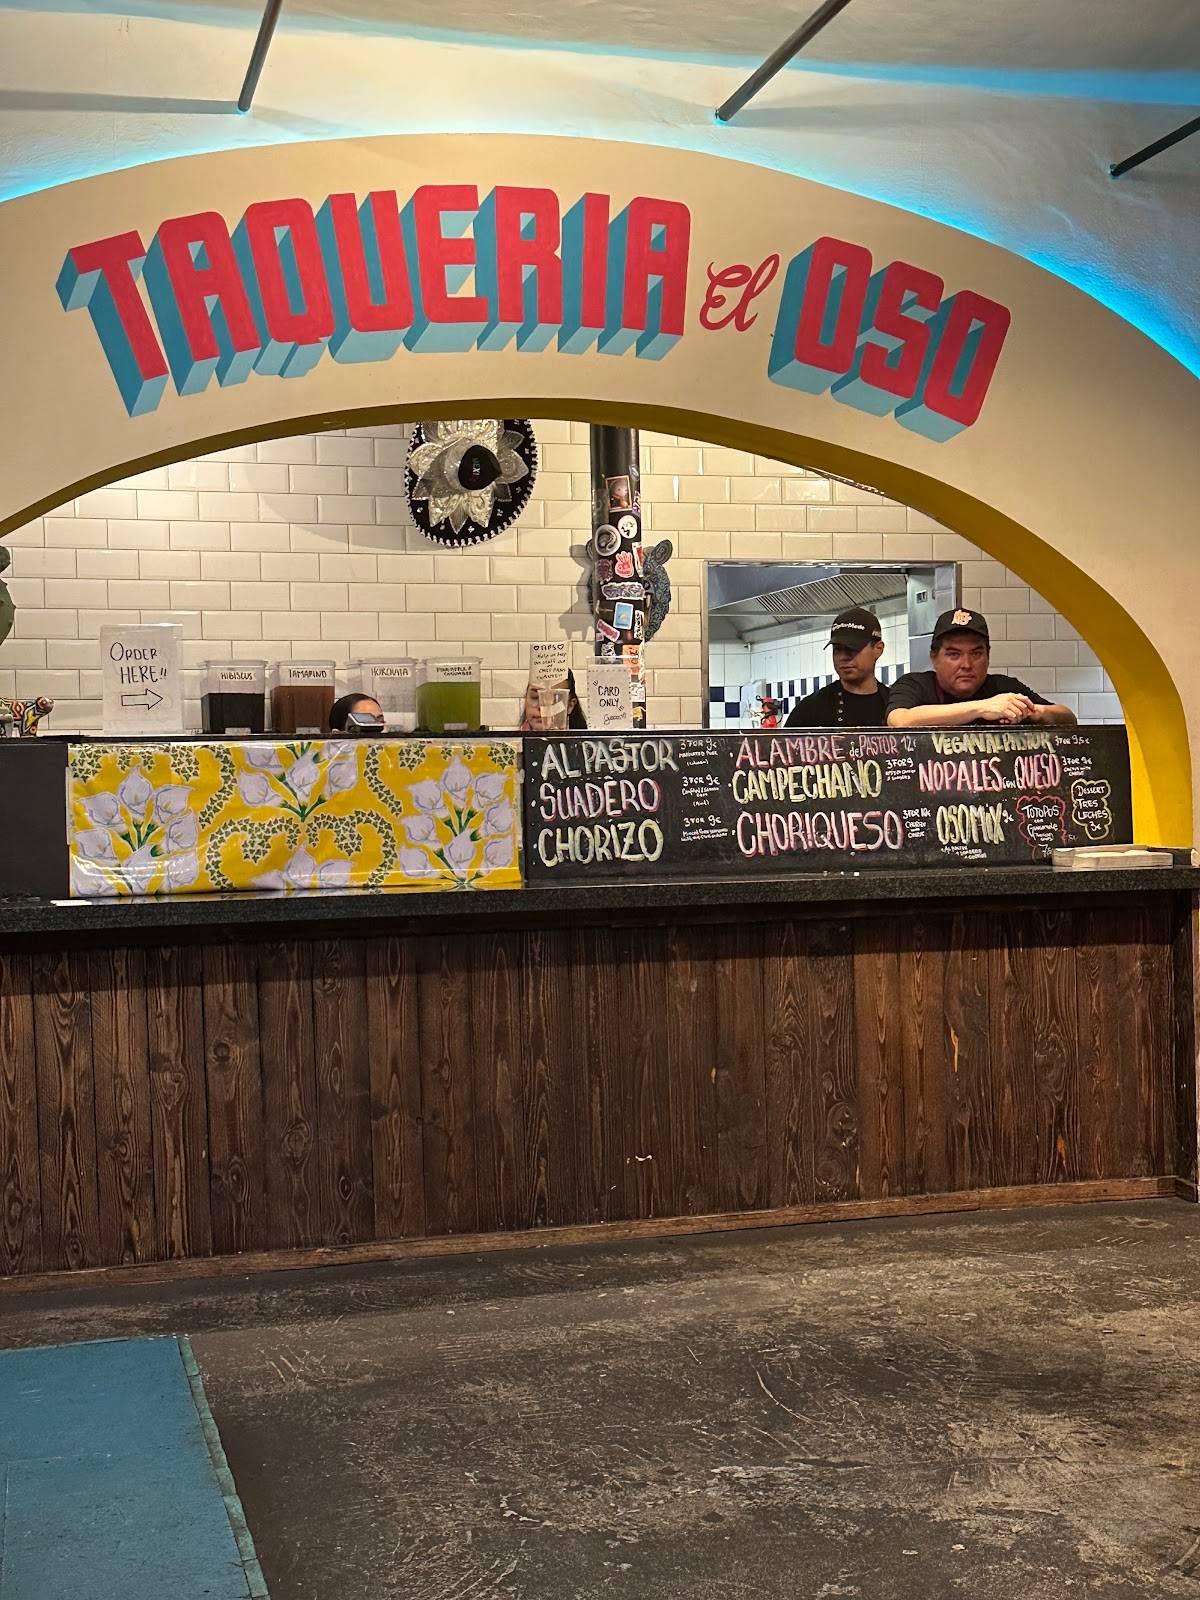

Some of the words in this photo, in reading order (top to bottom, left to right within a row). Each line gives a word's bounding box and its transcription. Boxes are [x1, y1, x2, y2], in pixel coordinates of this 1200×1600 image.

[56, 185, 691, 417] TAQUERIA
[699, 254, 780, 331] El
[768, 236, 1011, 443] OSO
[110, 642, 158, 662] ORDER
[120, 665, 167, 684] HERE!!
[221, 672, 253, 681] HIBISCUS
[597, 685, 620, 696] CARD
[599, 698, 619, 707] ONLY
[541, 742, 581, 780] AL
[582, 738, 679, 774] PASTOR
[735, 735, 846, 769] ALAMBRE
[859, 735, 898, 758] PASTOR
[732, 760, 882, 804] CAMPECHANO
[918, 757, 1003, 793] NOPALES
[1014, 753, 1061, 790] QUESO
[539, 776, 661, 823] SUADERO
[1021, 804, 1061, 819] TOTOPOS
[1077, 809, 1108, 820] LECHES
[538, 818, 664, 868] CHORIZO
[736, 810, 905, 858] CHORIQUESO
